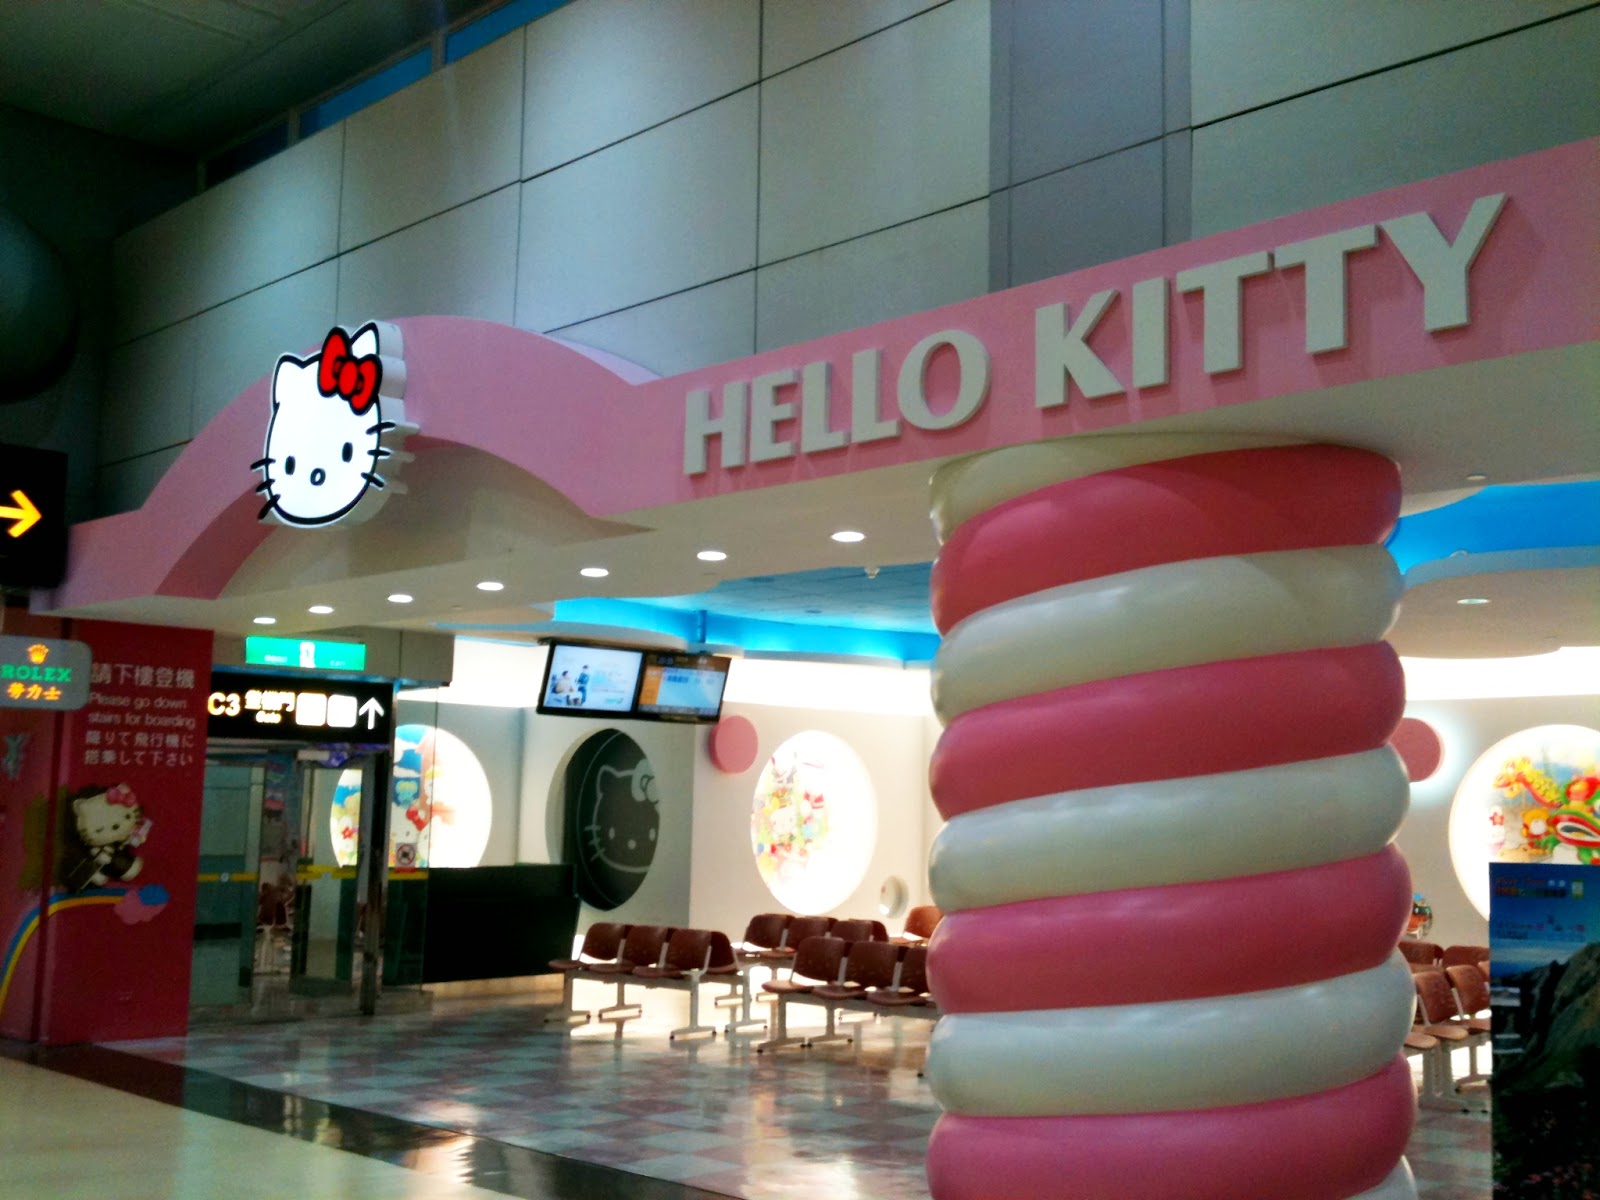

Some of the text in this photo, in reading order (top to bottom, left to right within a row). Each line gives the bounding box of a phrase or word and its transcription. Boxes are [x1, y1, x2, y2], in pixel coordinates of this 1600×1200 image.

[682, 191, 1509, 476] HELLO KITTY
[1, 664, 72, 682] ROLEX
[133, 697, 151, 710] go
[154, 696, 187, 709] down
[207, 691, 241, 716] C3
[125, 712, 141, 725] for
[144, 713, 196, 730] boarding
